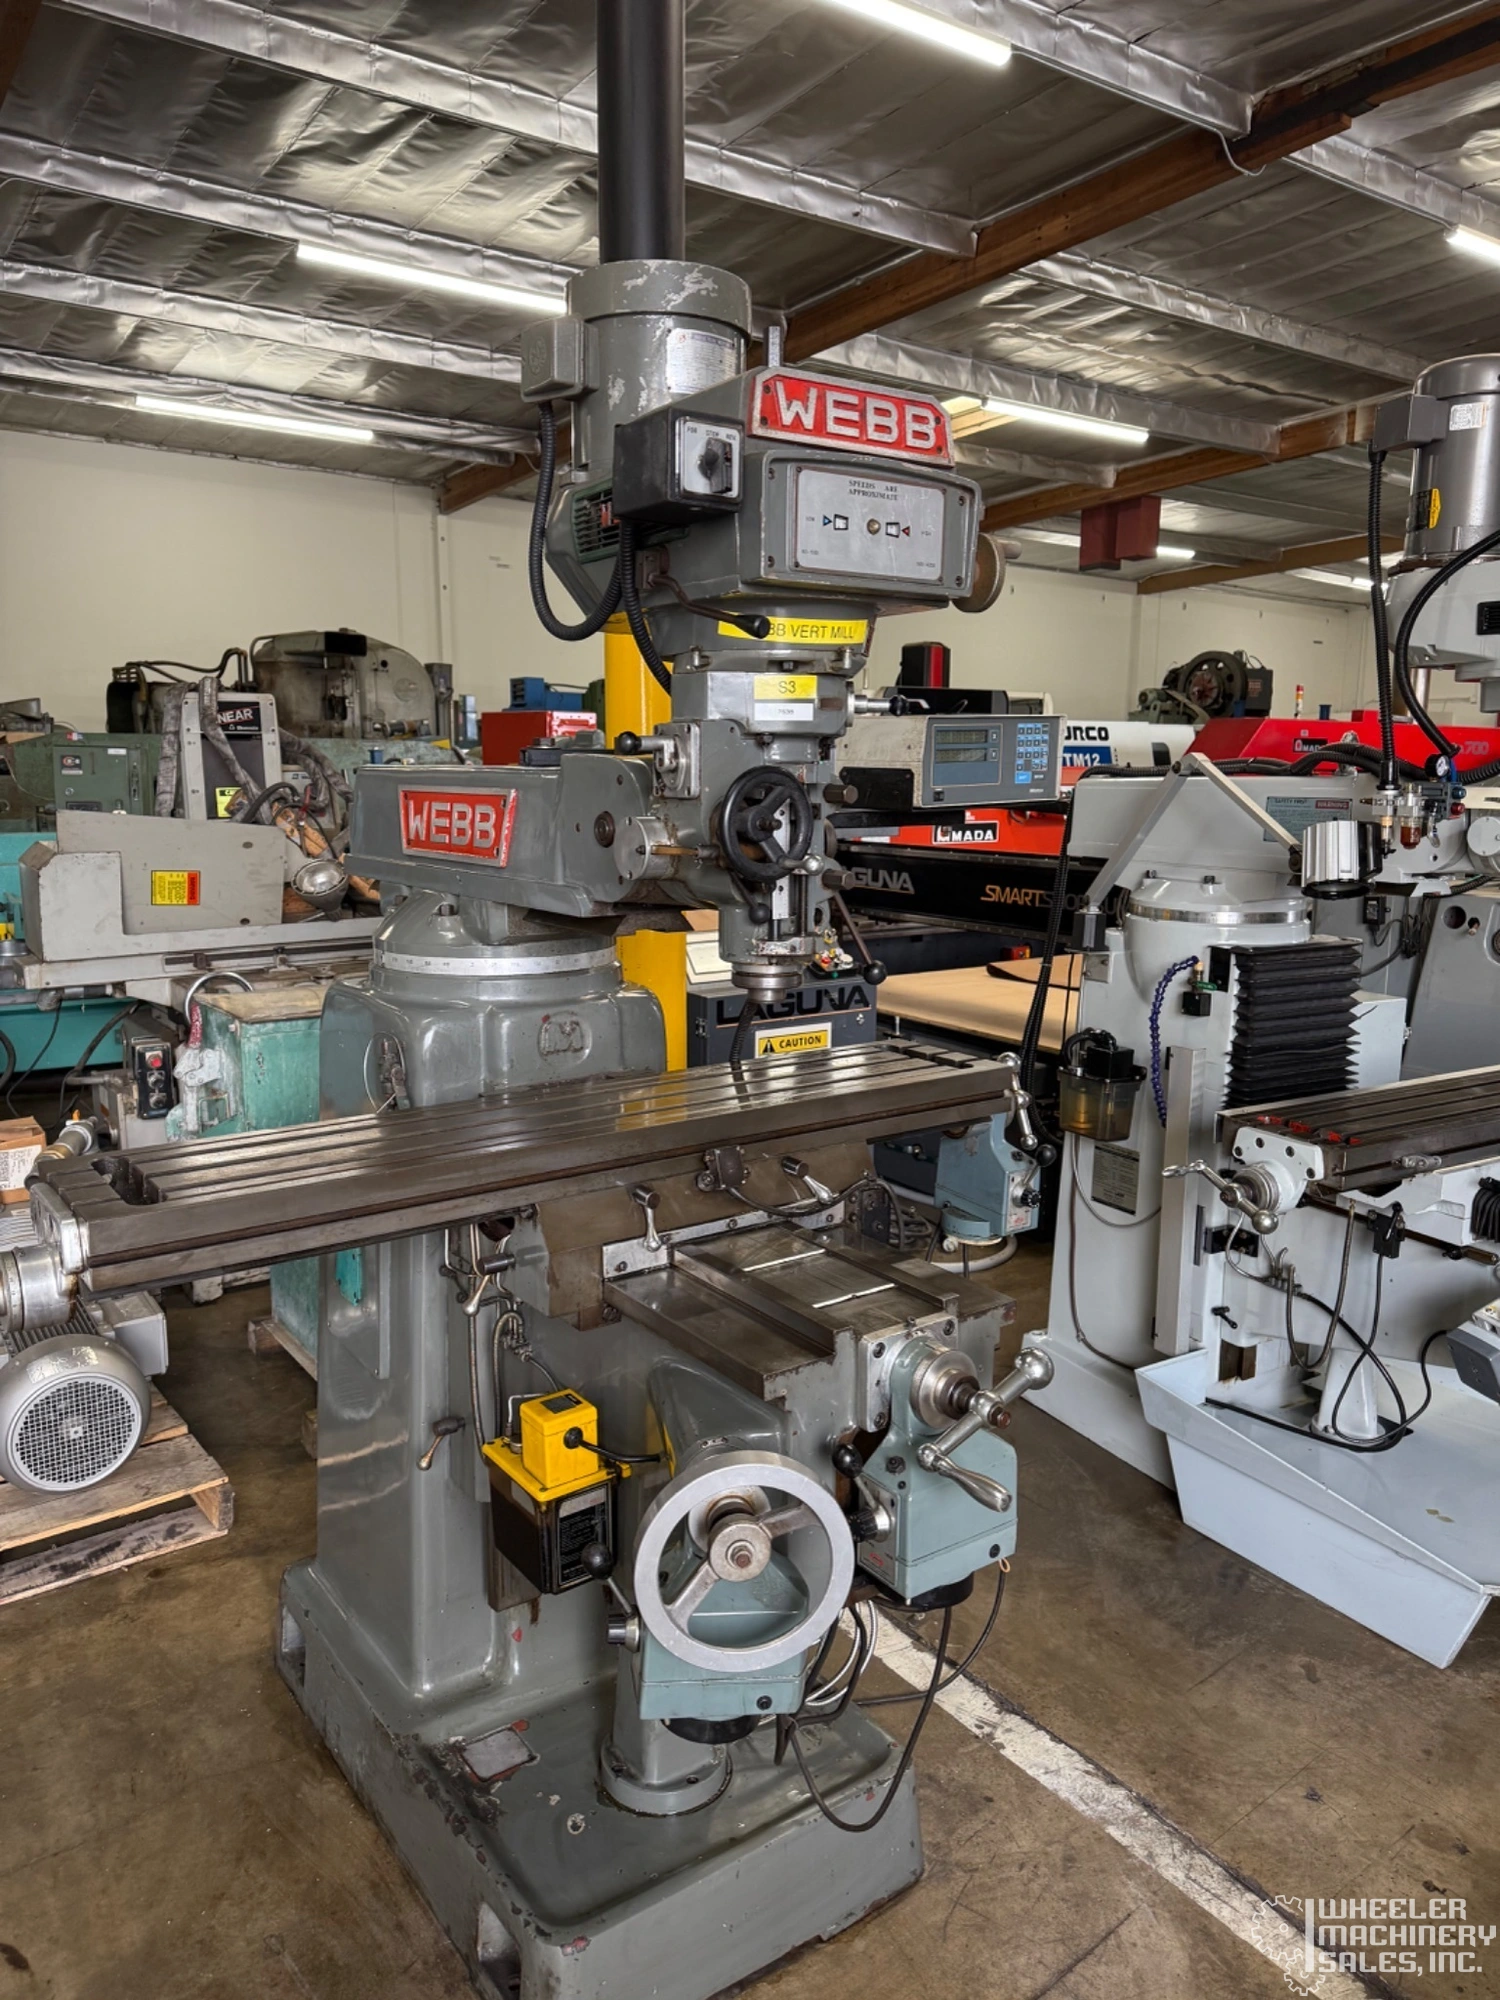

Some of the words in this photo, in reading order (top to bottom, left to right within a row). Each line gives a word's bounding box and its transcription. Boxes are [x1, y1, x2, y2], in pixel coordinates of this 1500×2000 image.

[776, 381, 937, 449] WEBB
[849, 480, 876, 490] SPEEDS
[849, 489, 898, 500] APPROXIMATE
[768, 623, 786, 636] BB
[791, 624, 828, 639] VERT
[830, 626, 853, 639] MILL
[778, 681, 797, 694] S3
[217, 708, 254, 724] NEAR
[1064, 726, 1109, 741] URCO
[1062, 753, 1101, 767] TM12
[408, 800, 497, 848] WEBB
[850, 867, 915, 894] GUNA
[779, 1035, 821, 1049] CAUTION
